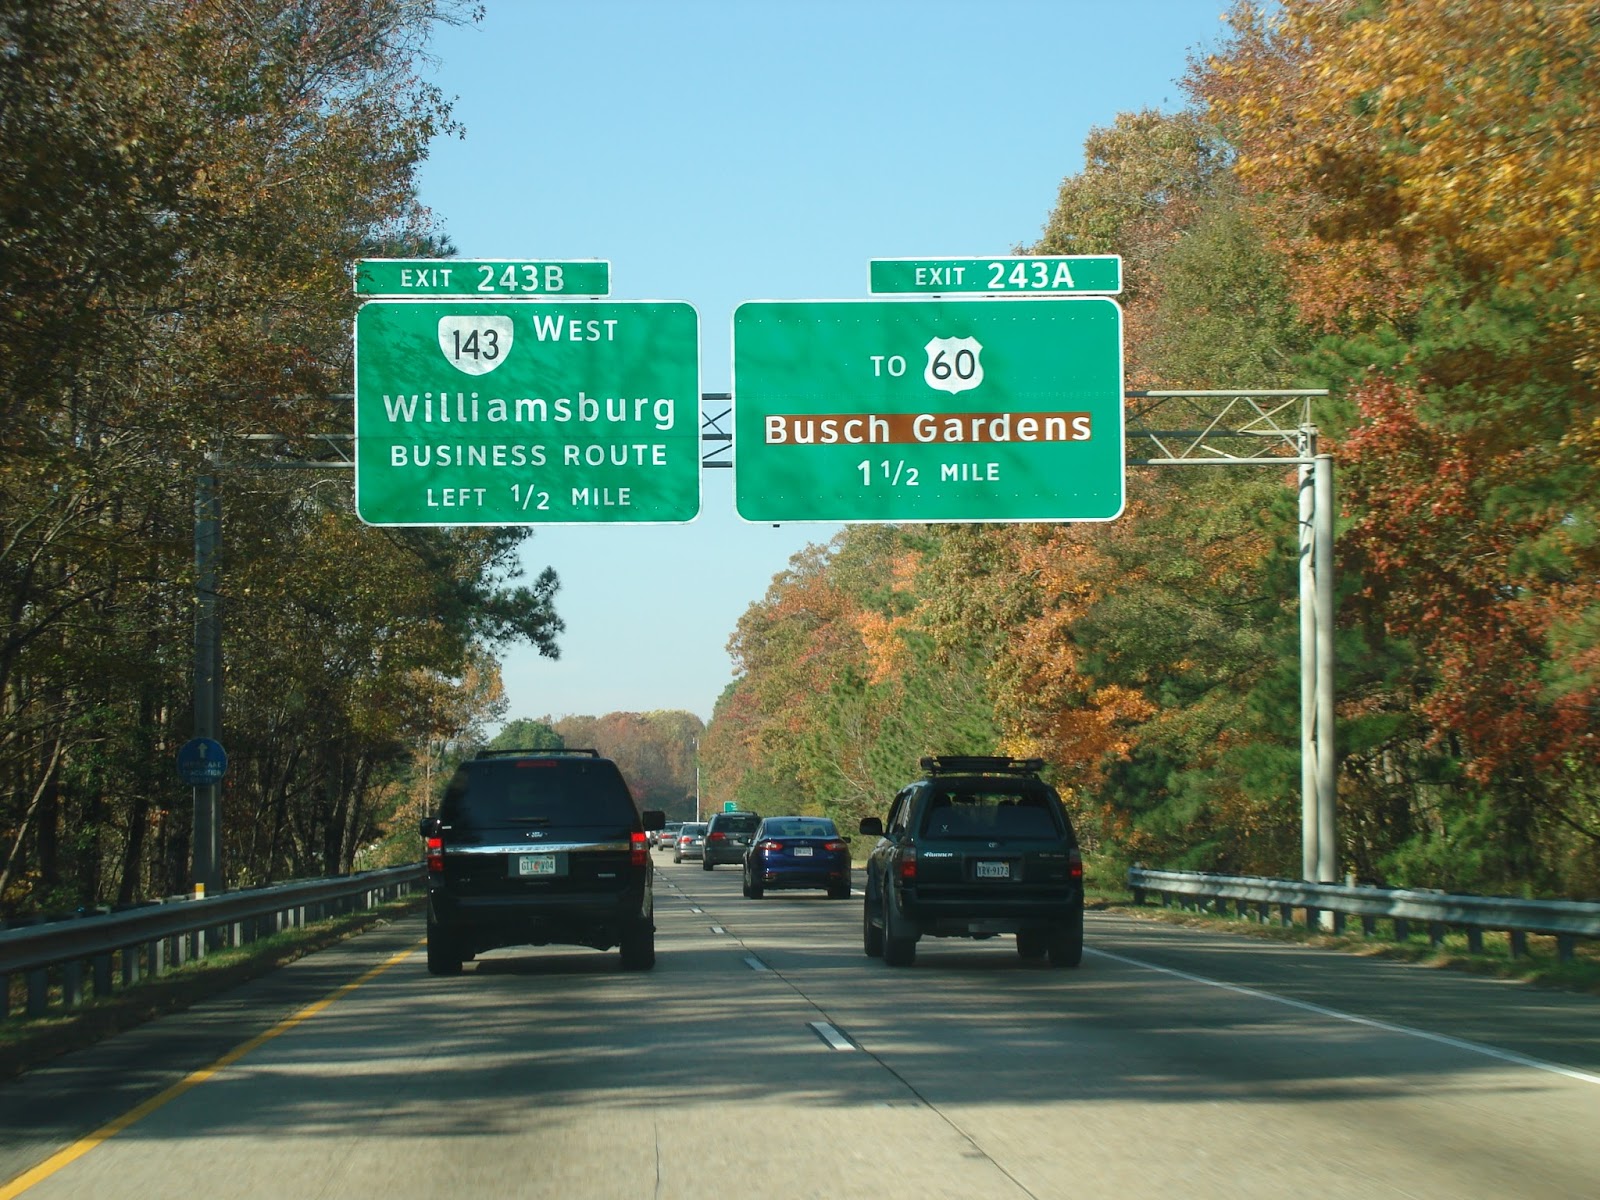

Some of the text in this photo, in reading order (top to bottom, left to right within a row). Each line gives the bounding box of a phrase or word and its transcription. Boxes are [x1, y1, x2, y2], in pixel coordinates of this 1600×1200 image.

[400, 264, 564, 292] EXIT 243B
[914, 262, 1075, 289] EXIT 243A
[532, 315, 618, 342] WEST
[452, 328, 499, 361] 143
[870, 355, 907, 377] TO
[931, 349, 975, 380] 60
[383, 392, 675, 430] Williamsburg
[765, 413, 1092, 444] Busch Gardens
[390, 444, 667, 467] BUSINESS ROUTE
[940, 463, 1000, 482] MILE
[426, 484, 631, 510] LEFT 1/2 MILE
